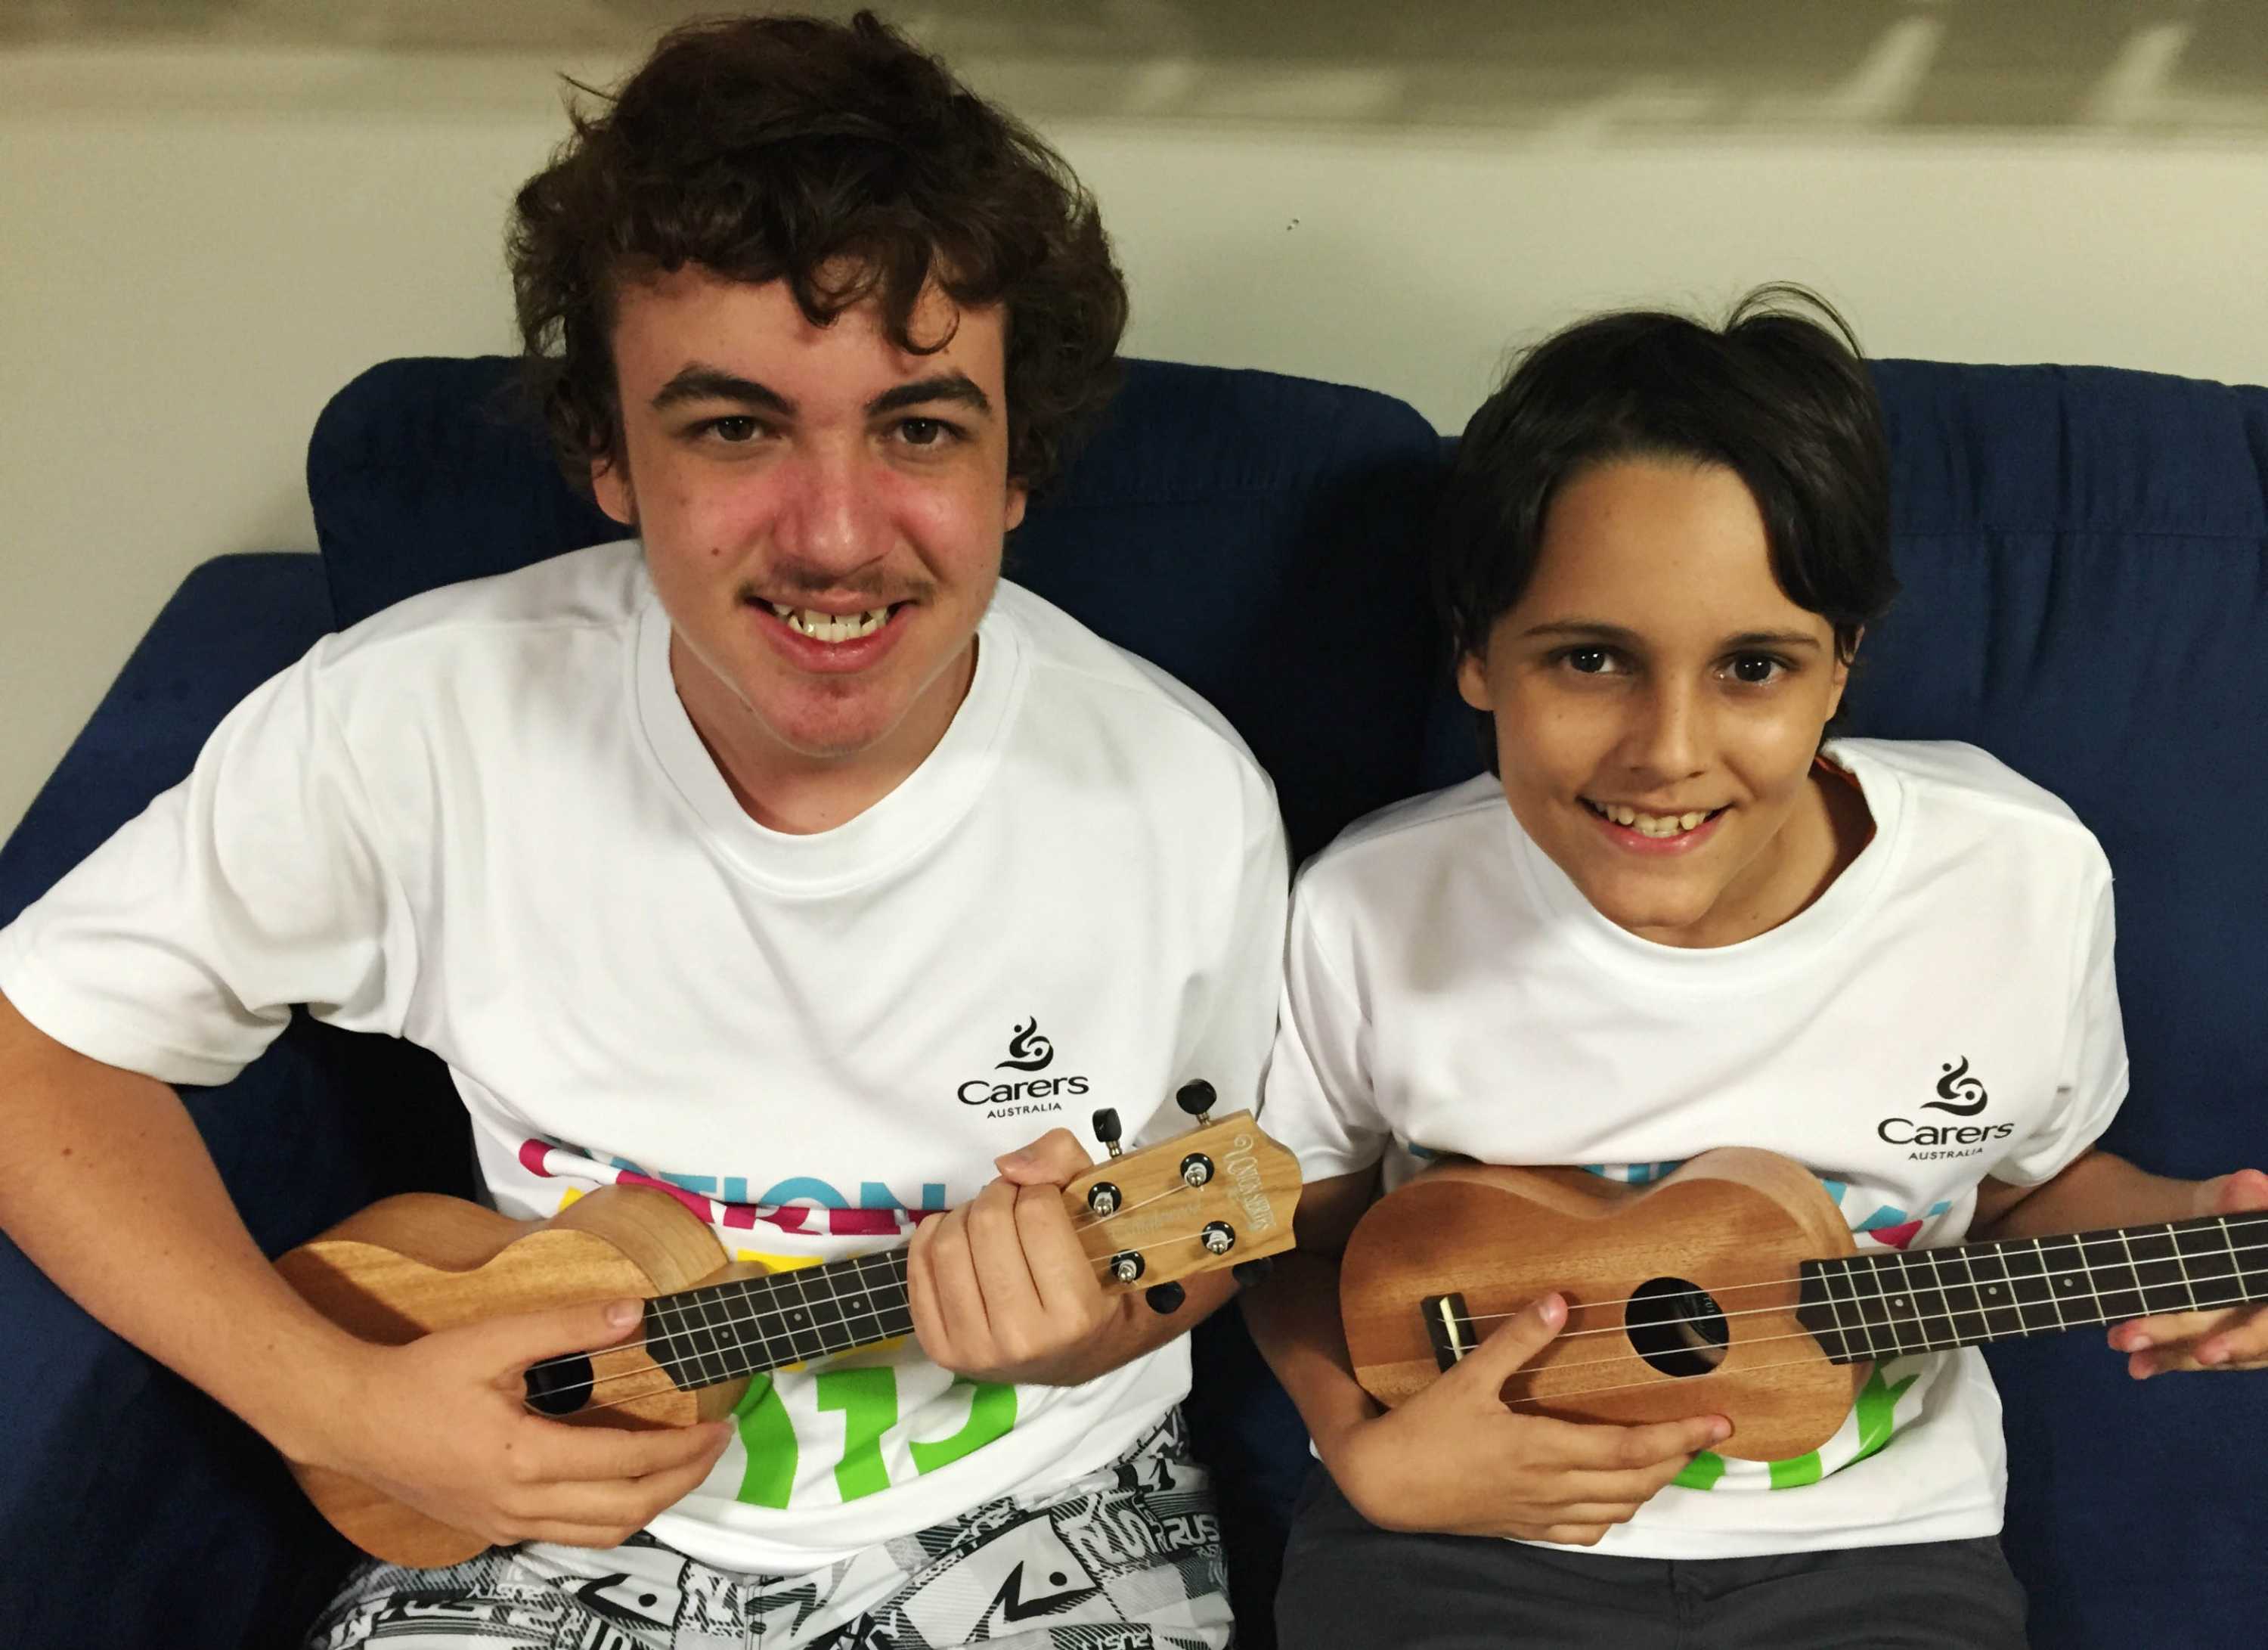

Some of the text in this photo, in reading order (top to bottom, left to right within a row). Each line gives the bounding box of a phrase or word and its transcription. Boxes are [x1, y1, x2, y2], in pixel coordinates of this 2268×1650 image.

[957, 1075, 1089, 1106] Carers
[987, 1102, 1062, 1119] AUSTRALIA
[1877, 1117, 2015, 1146] Carers
[1908, 1148, 1983, 1161] AUSTRALIA
